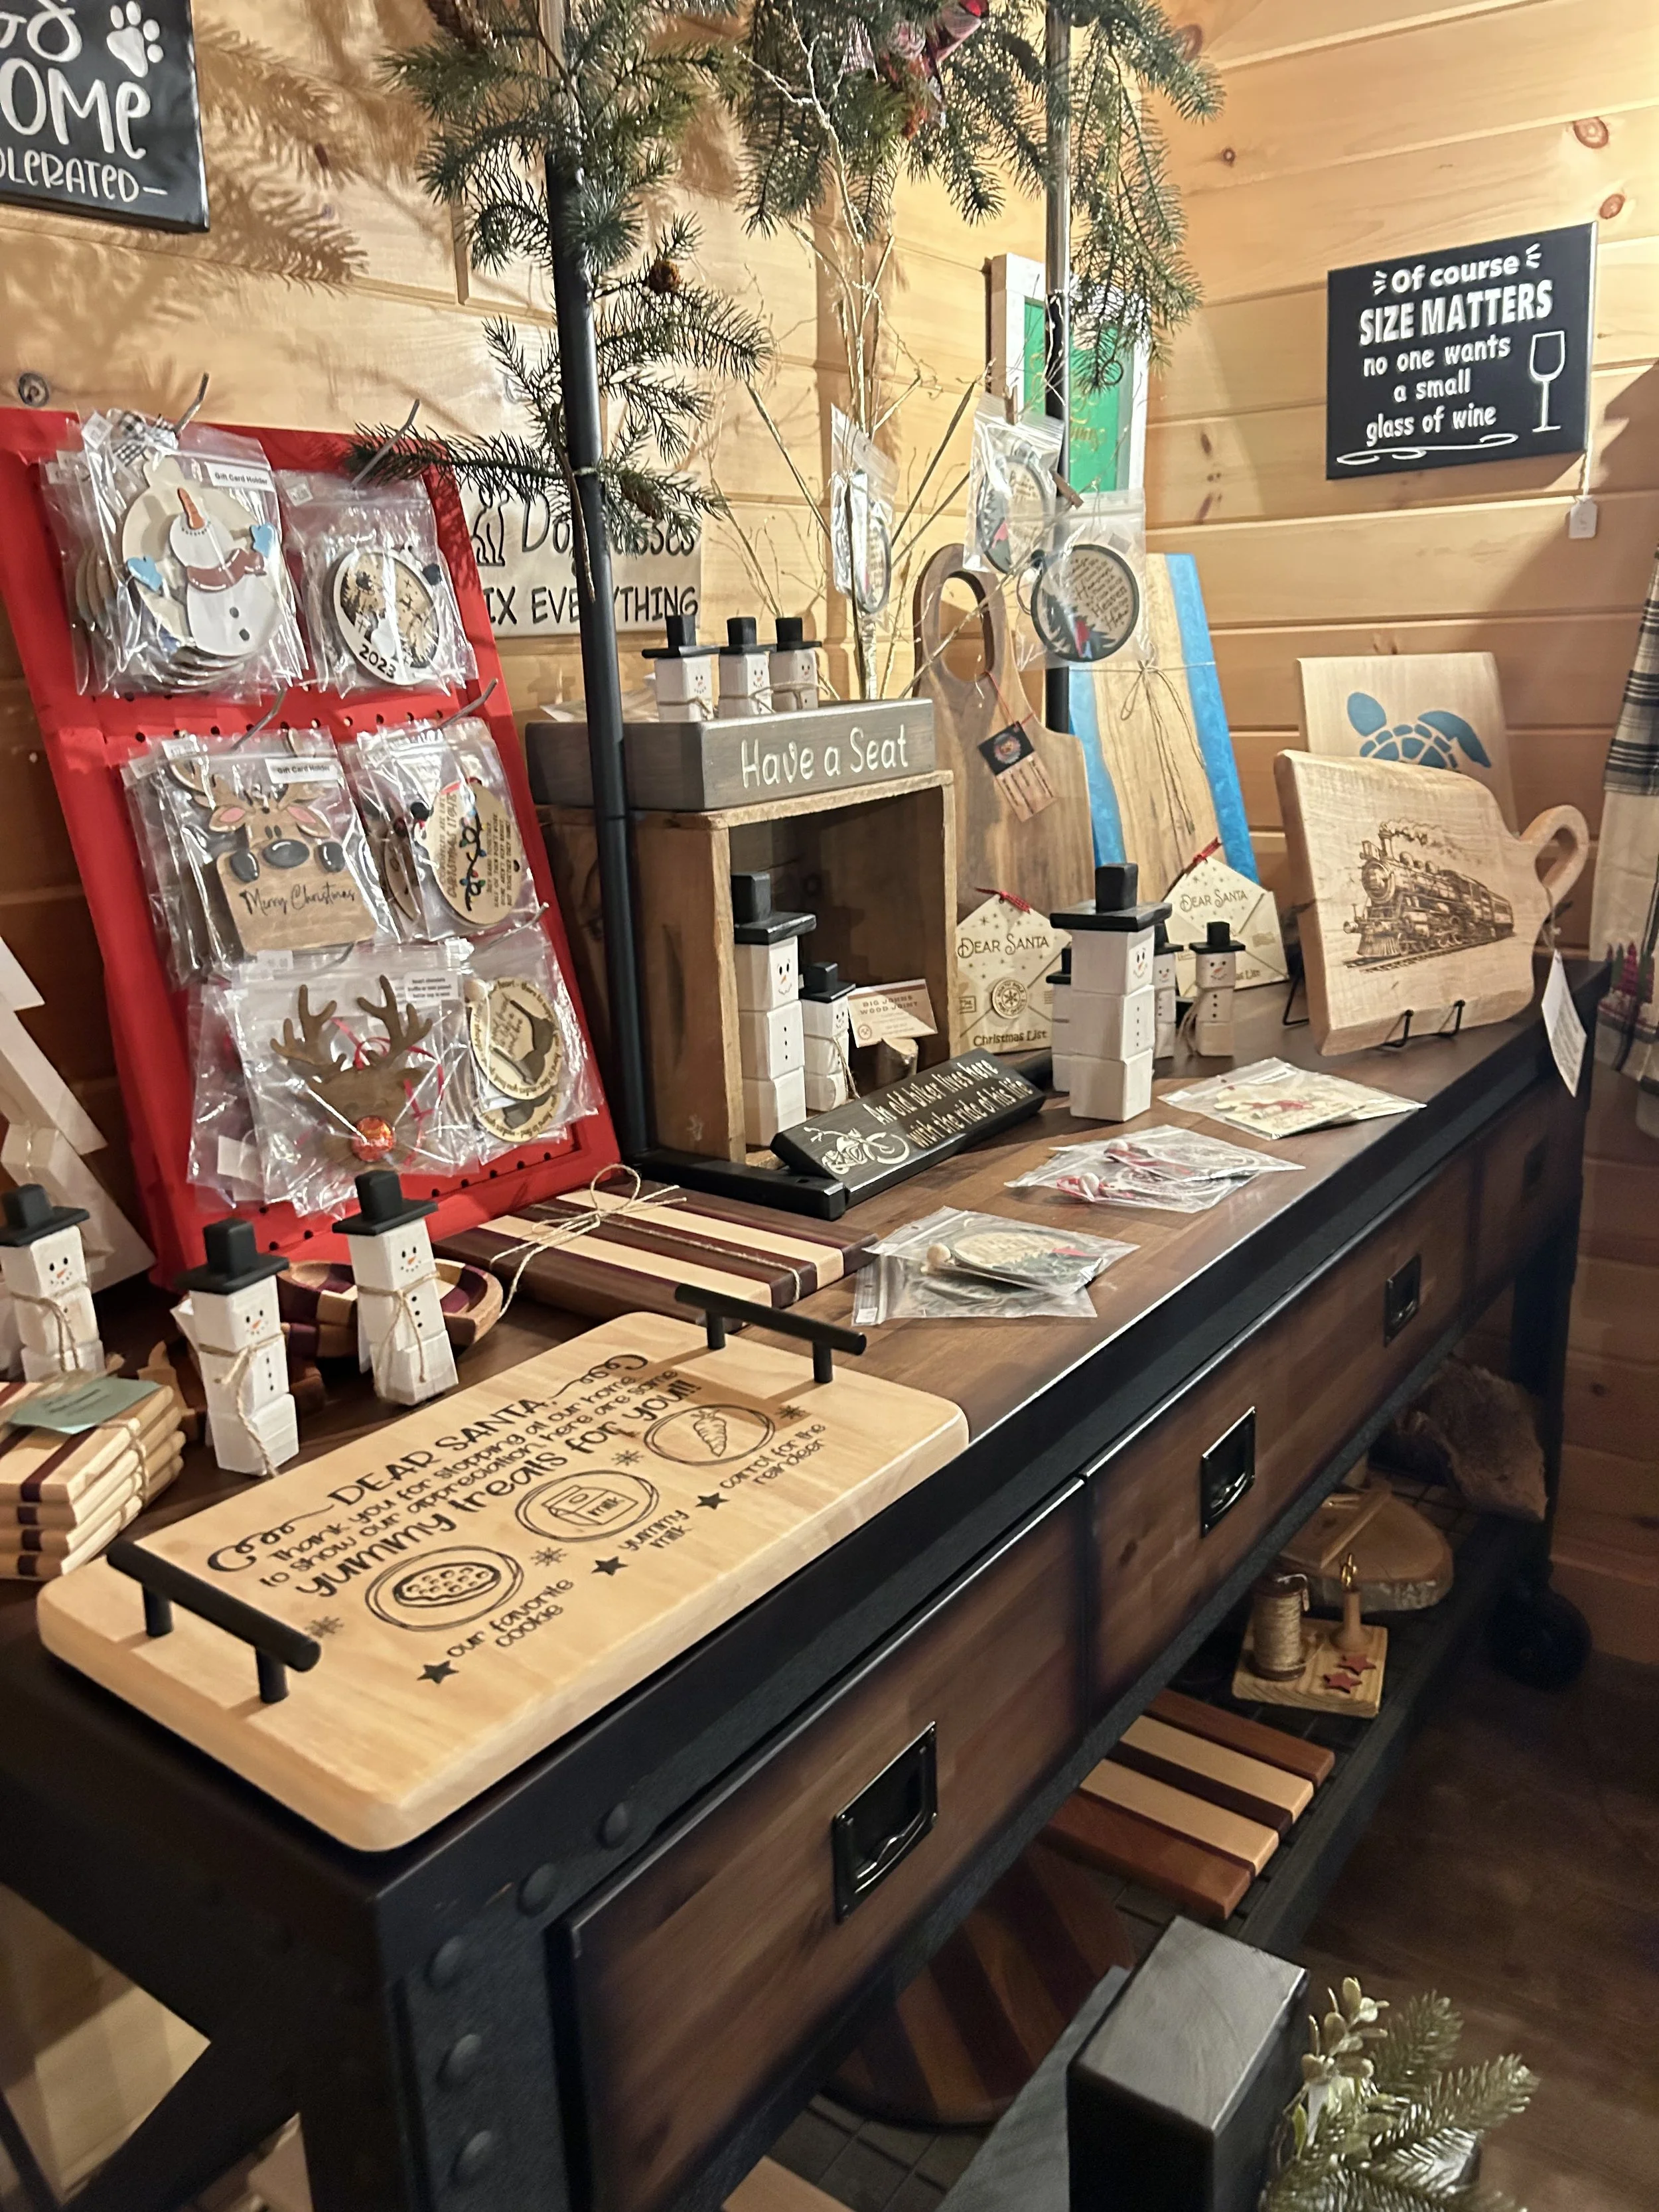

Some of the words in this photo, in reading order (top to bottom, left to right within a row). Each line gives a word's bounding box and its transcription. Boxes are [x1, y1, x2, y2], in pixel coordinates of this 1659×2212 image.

[1391, 264, 1427, 293] Of
[1429, 254, 1521, 287] course
[1359, 301, 1415, 346] SIZE
[1421, 279, 1553, 337] MATTERS
[1363, 356, 1389, 377] no
[1397, 348, 1435, 372] one
[1444, 333, 1512, 366] wants
[1393, 383, 1407, 403] a
[1415, 367, 1472, 400] small
[1366, 413, 1415, 447] glass
[1422, 404, 1445, 434] of
[1453, 403, 1497, 431] wine
[359, 644, 396, 680] 2023
[741, 738, 815, 789] Have
[824, 746, 841, 777] a
[849, 723, 909, 774] Seat
[239, 887, 287, 917] Merry
[291, 880, 356, 911] Christmas
[974, 1031, 1025, 1047] Christmas
[1027, 1029, 1048, 1042] List
[931, 1070, 974, 1093] lives
[957, 1059, 998, 1080] here
[887, 1090, 918, 1116] old
[901, 1082, 946, 1108] biker
[976, 1090, 996, 1114] of
[982, 1086, 1017, 1108] his
[998, 1077, 1034, 1100] life
[863, 1103, 897, 1126] An
[931, 1112, 965, 1134] the
[954, 1099, 988, 1125] ride
[906, 1119, 945, 1148] with
[327, 1449, 443, 1506] DEAR
[435, 1396, 557, 1452] SANTA,
[348, 1499, 397, 1524] you
[396, 1479, 431, 1501] for
[434, 1432, 526, 1481] stopping
[526, 1420, 550, 1436] at
[547, 1402, 582, 1422] our
[579, 1376, 638, 1408] home
[719, 1455, 776, 1489] carrot
[770, 1439, 799, 1457] for
[794, 1424, 826, 1440] the
[753, 1439, 826, 1485] reindeer
[259, 1571, 290, 1588] to
[289, 1536, 357, 1572] show
[359, 1512, 401, 1537] our
[407, 1441, 547, 1514] appreciation
[541, 1414, 593, 1442] here
[594, 1395, 631, 1416] are
[628, 1370, 678, 1396] some
[296, 1513, 458, 1597] yummy
[447, 1451, 569, 1514] treats
[565, 1419, 618, 1454] for
[587, 1496, 625, 1517] milk
[618, 1509, 690, 1552] yummy
[649, 1524, 692, 1550] milk
[447, 1631, 486, 1659] our
[489, 1578, 575, 1633] favorite
[496, 1603, 564, 1649] cookie
